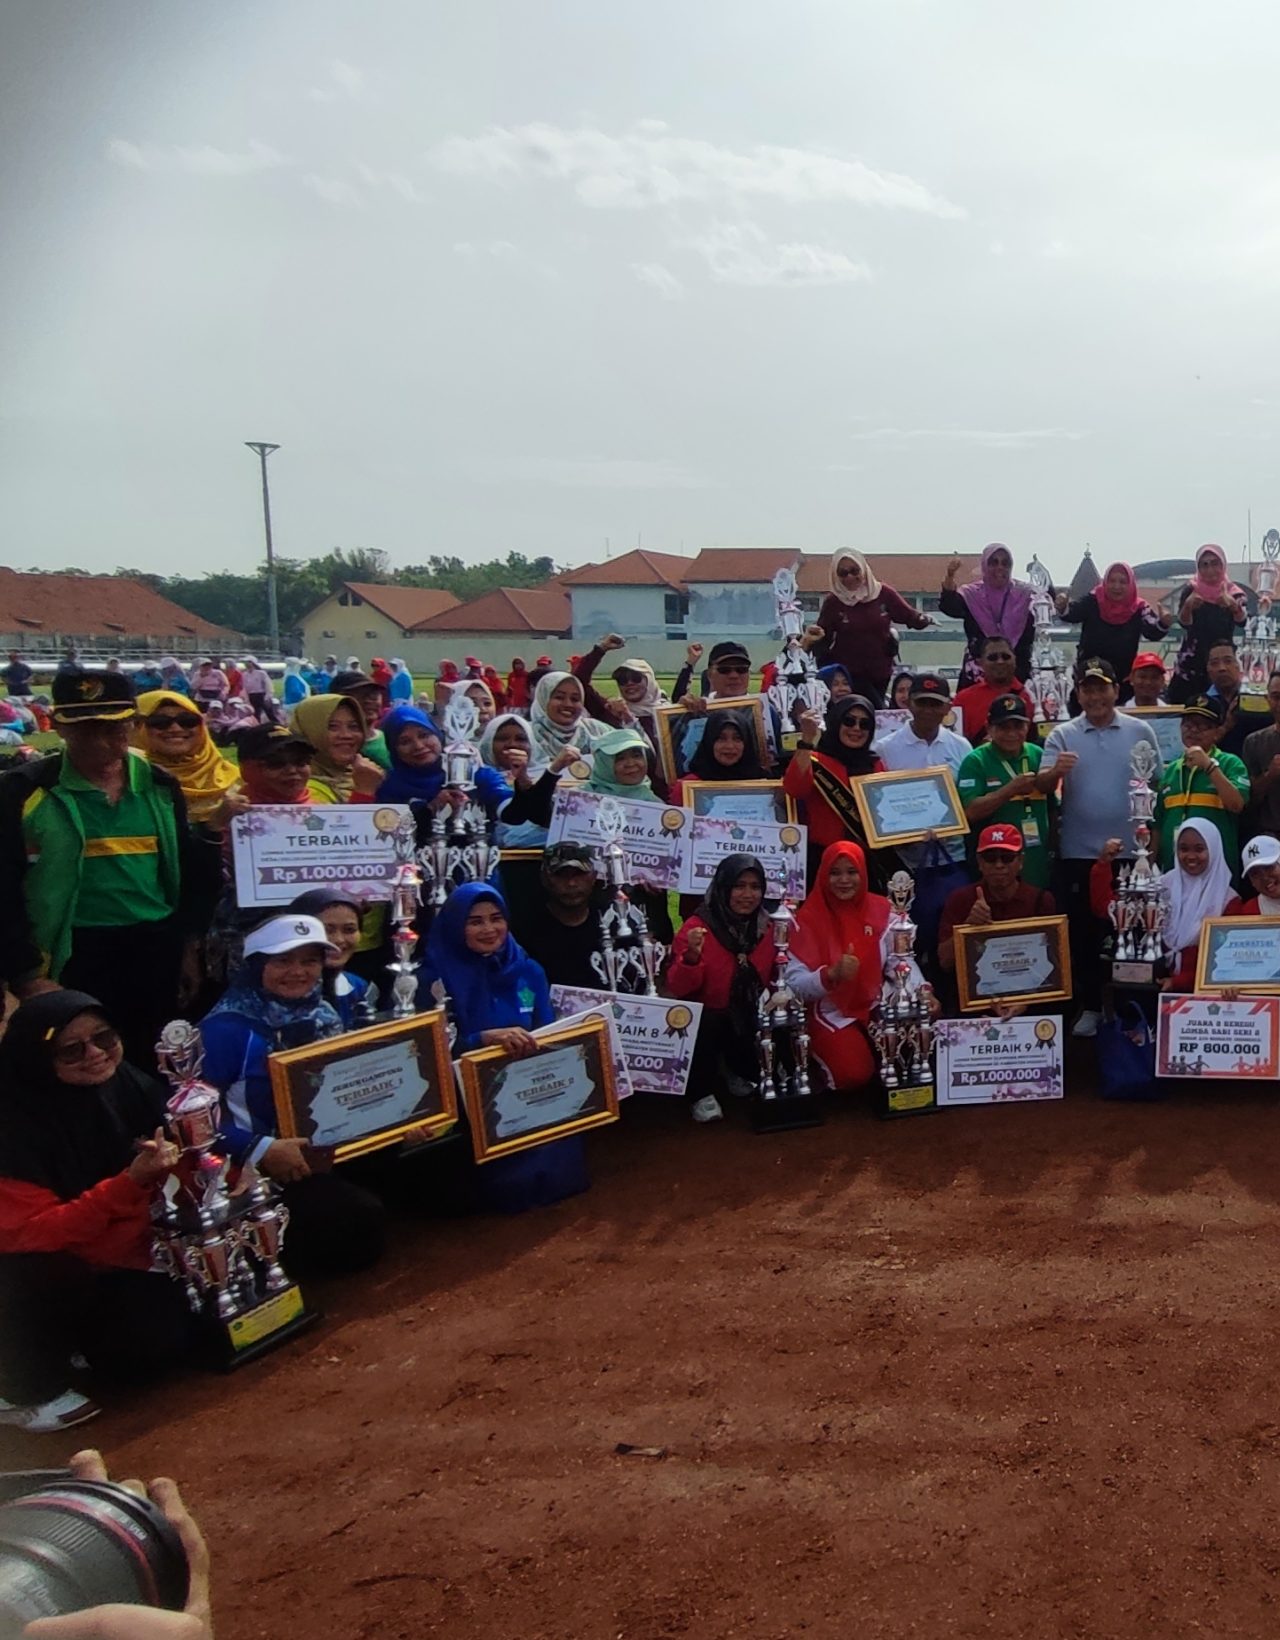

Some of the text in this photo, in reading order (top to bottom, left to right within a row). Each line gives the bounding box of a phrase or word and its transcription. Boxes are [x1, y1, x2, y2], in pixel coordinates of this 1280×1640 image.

[647, 827, 655, 838] 6
[286, 835, 360, 847] TERBAIK
[714, 841, 776, 854] TERBAIK 3
[272, 864, 386, 883] Rp 1.000.000
[651, 1028, 660, 1038] 8
[969, 1043, 1032, 1055] TERBAIK 9
[1179, 1042, 1260, 1054] RP 800.000
[961, 1069, 1040, 1086] Rp 1.000.000
[335, 1080, 394, 1105] TERBAIK
[514, 1079, 566, 1100] TERBAIK
